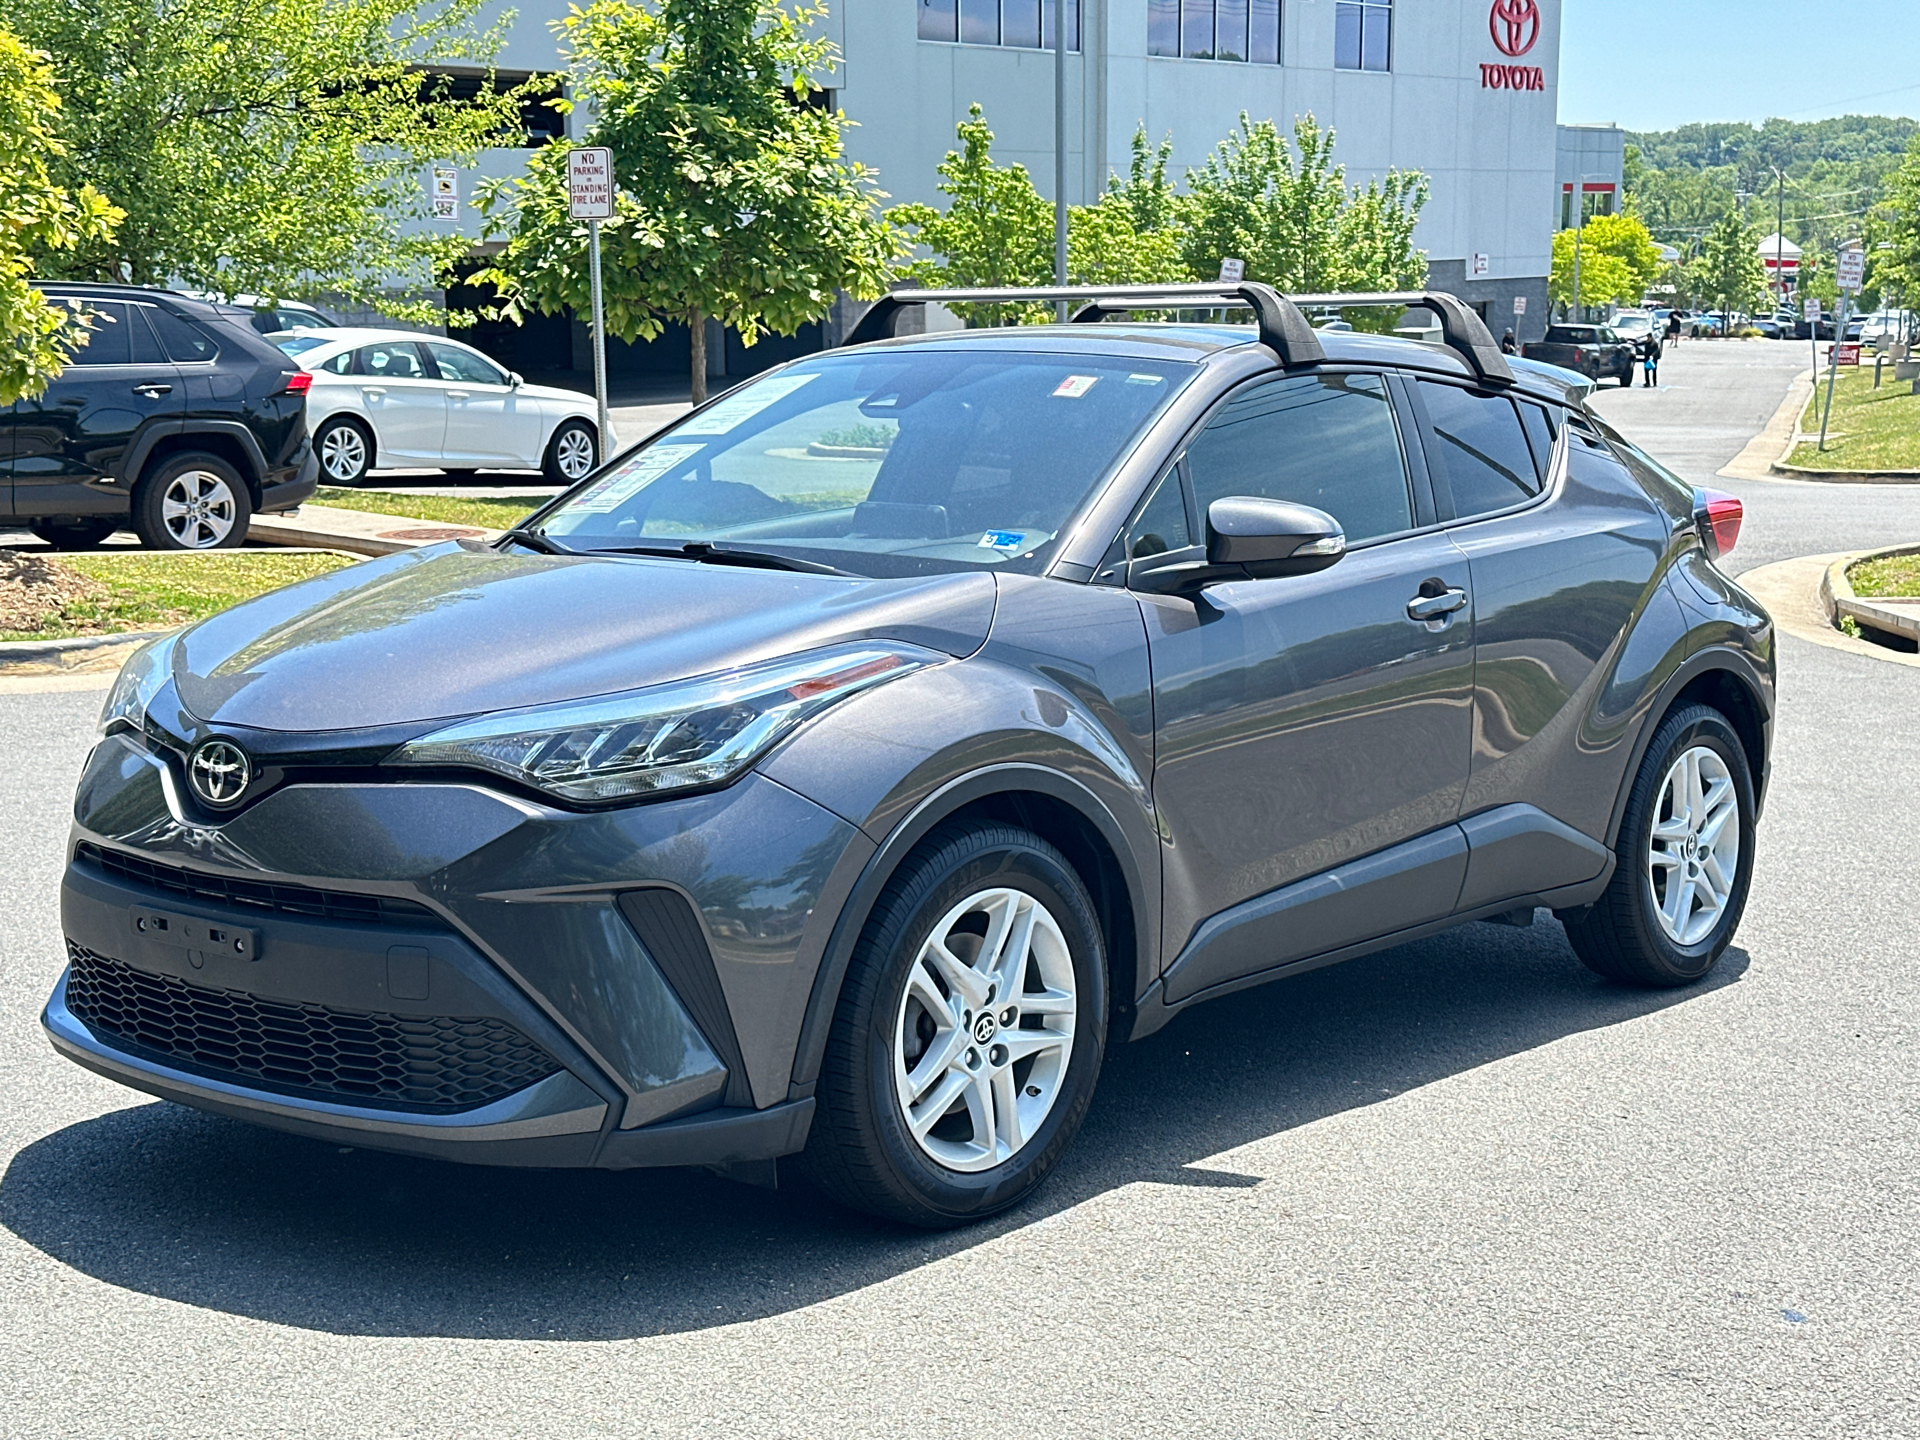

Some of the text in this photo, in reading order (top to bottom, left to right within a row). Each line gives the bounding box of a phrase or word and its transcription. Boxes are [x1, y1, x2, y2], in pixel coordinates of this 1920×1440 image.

[1479, 64, 1544, 91] TOYOTA
[581, 153, 595, 164] NO
[573, 166, 604, 175] PARKING
[572, 184, 607, 193] STANDING
[573, 195, 607, 204] FIRE LANE
